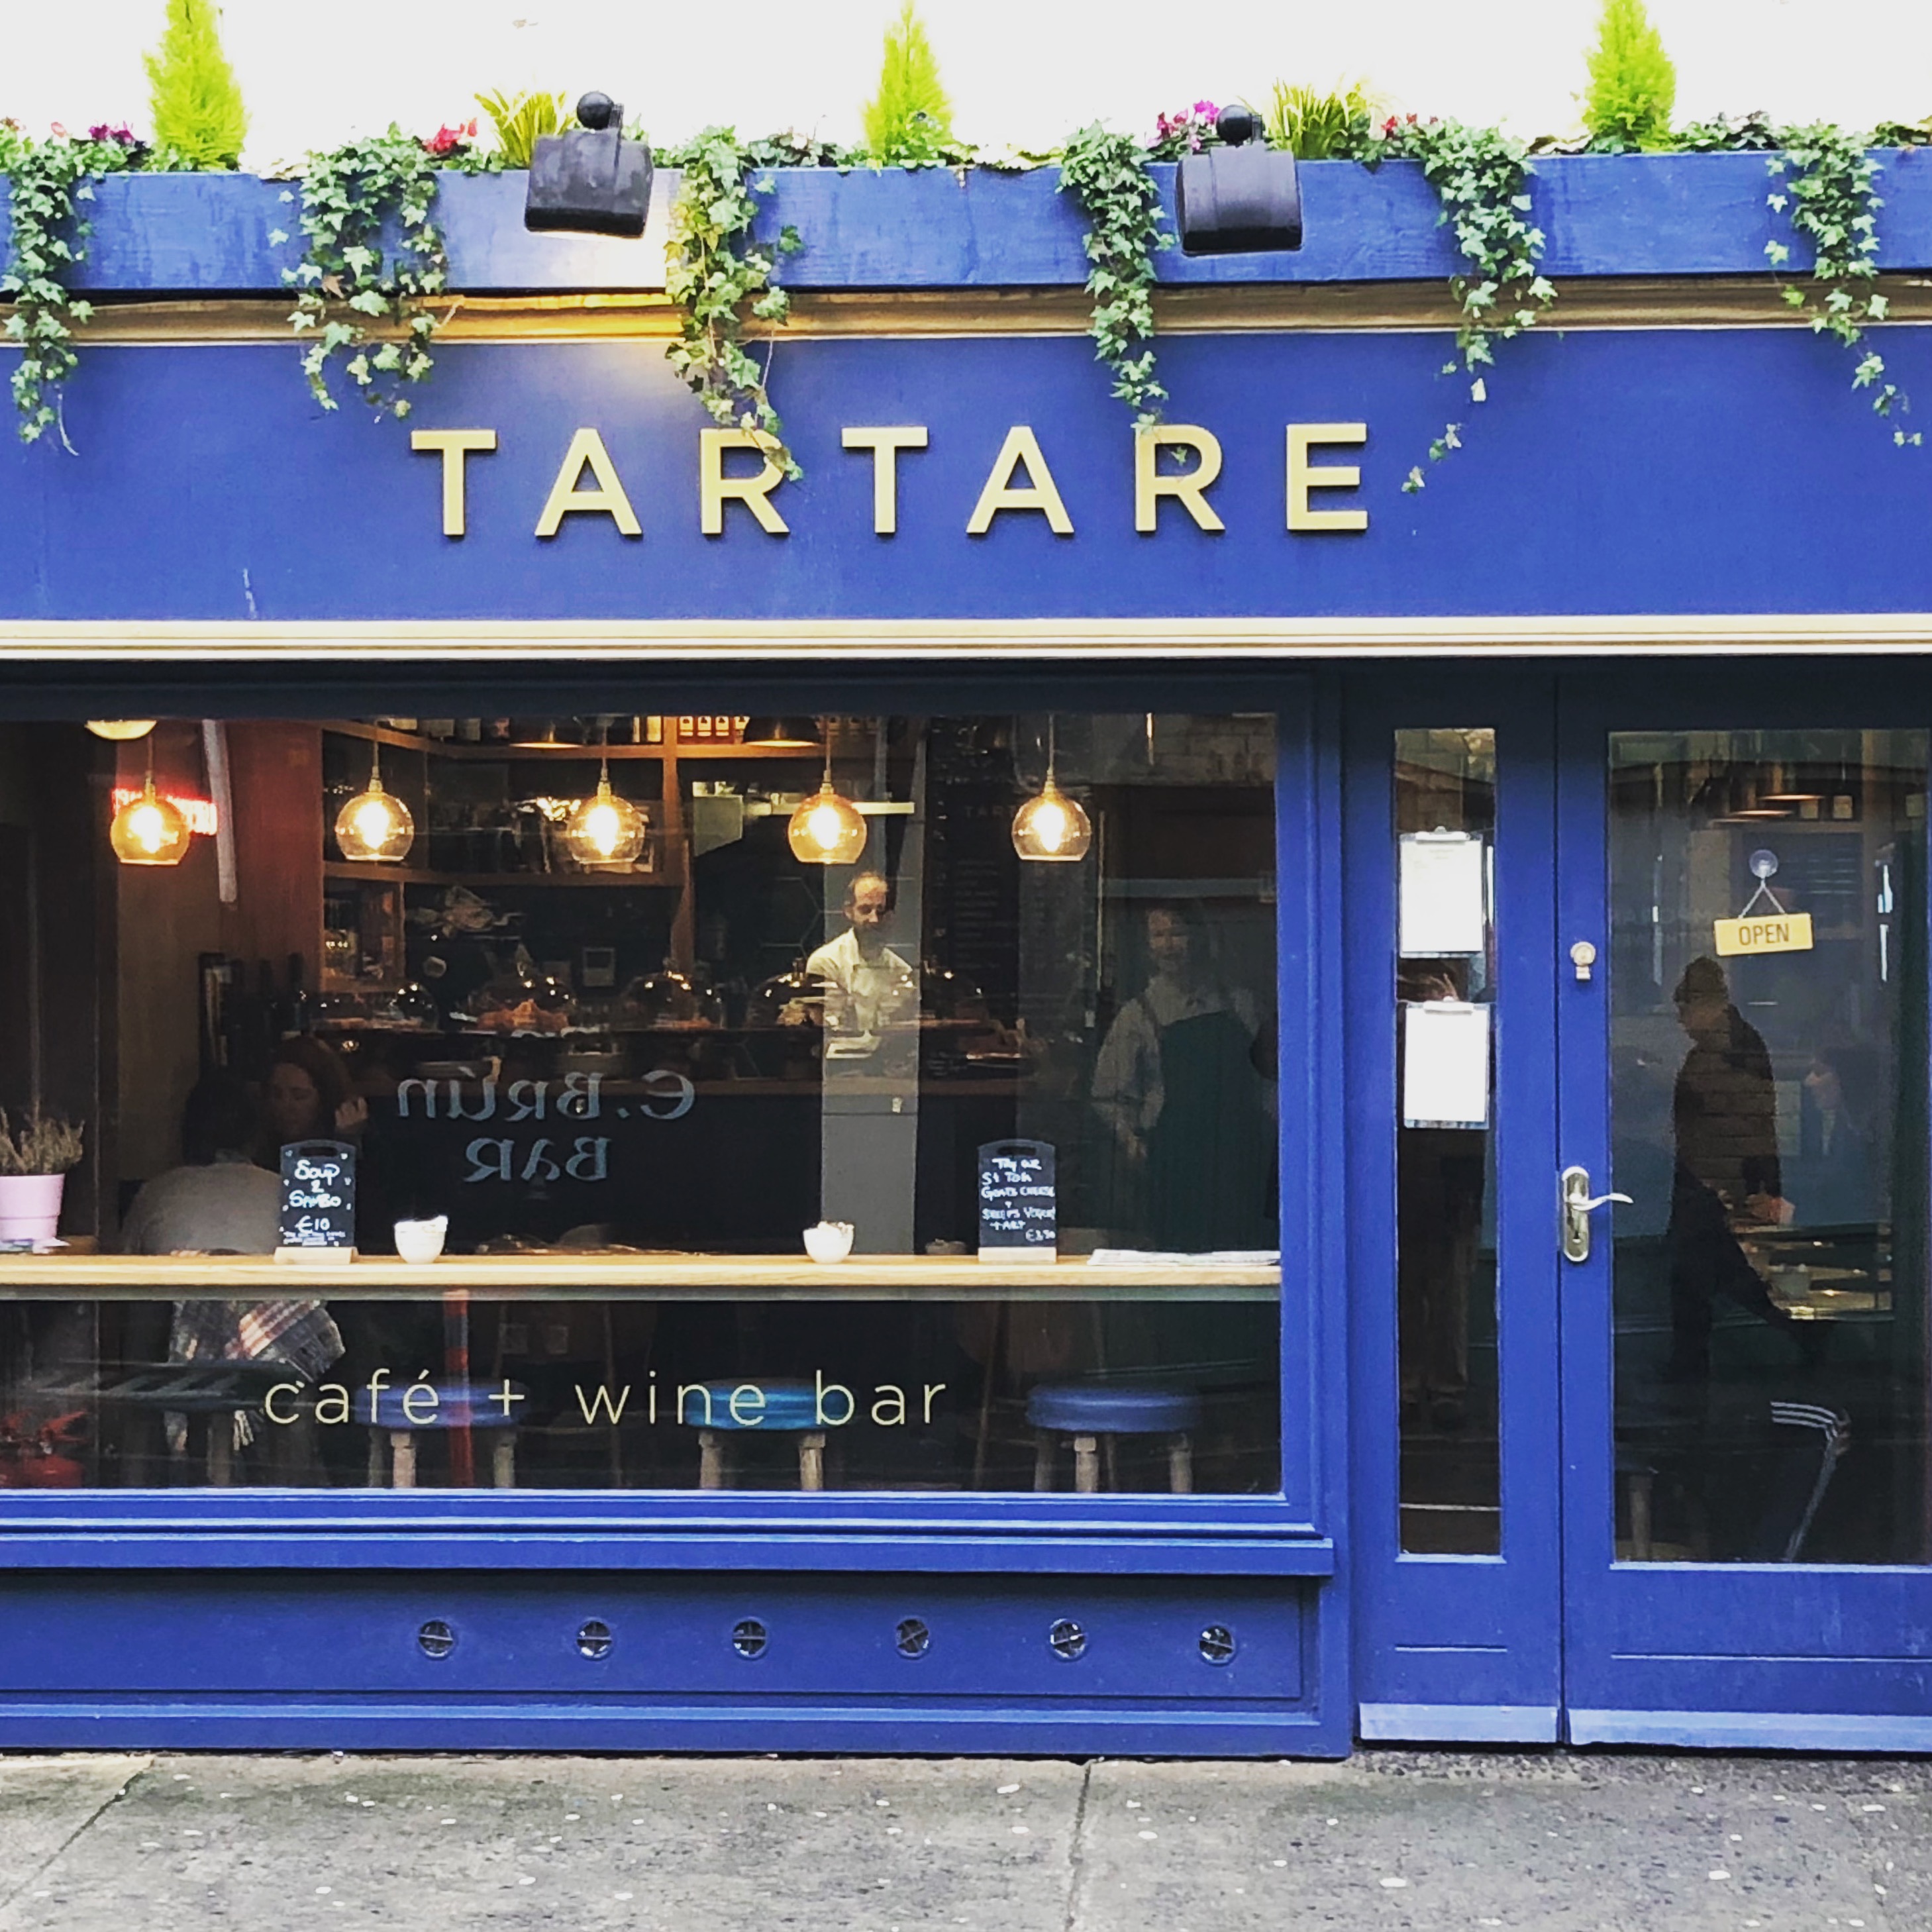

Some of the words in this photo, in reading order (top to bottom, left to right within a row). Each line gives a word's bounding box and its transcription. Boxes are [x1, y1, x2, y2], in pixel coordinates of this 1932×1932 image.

[411, 423, 1368, 536] TARTARE
[1739, 923, 1790, 945] OPEN
[294, 1159, 340, 1186] Soup
[294, 1215, 331, 1234] €10
[264, 1367, 439, 1425] café
[488, 1379, 525, 1417] +
[575, 1369, 766, 1426] wine
[816, 1369, 947, 1426] bar
